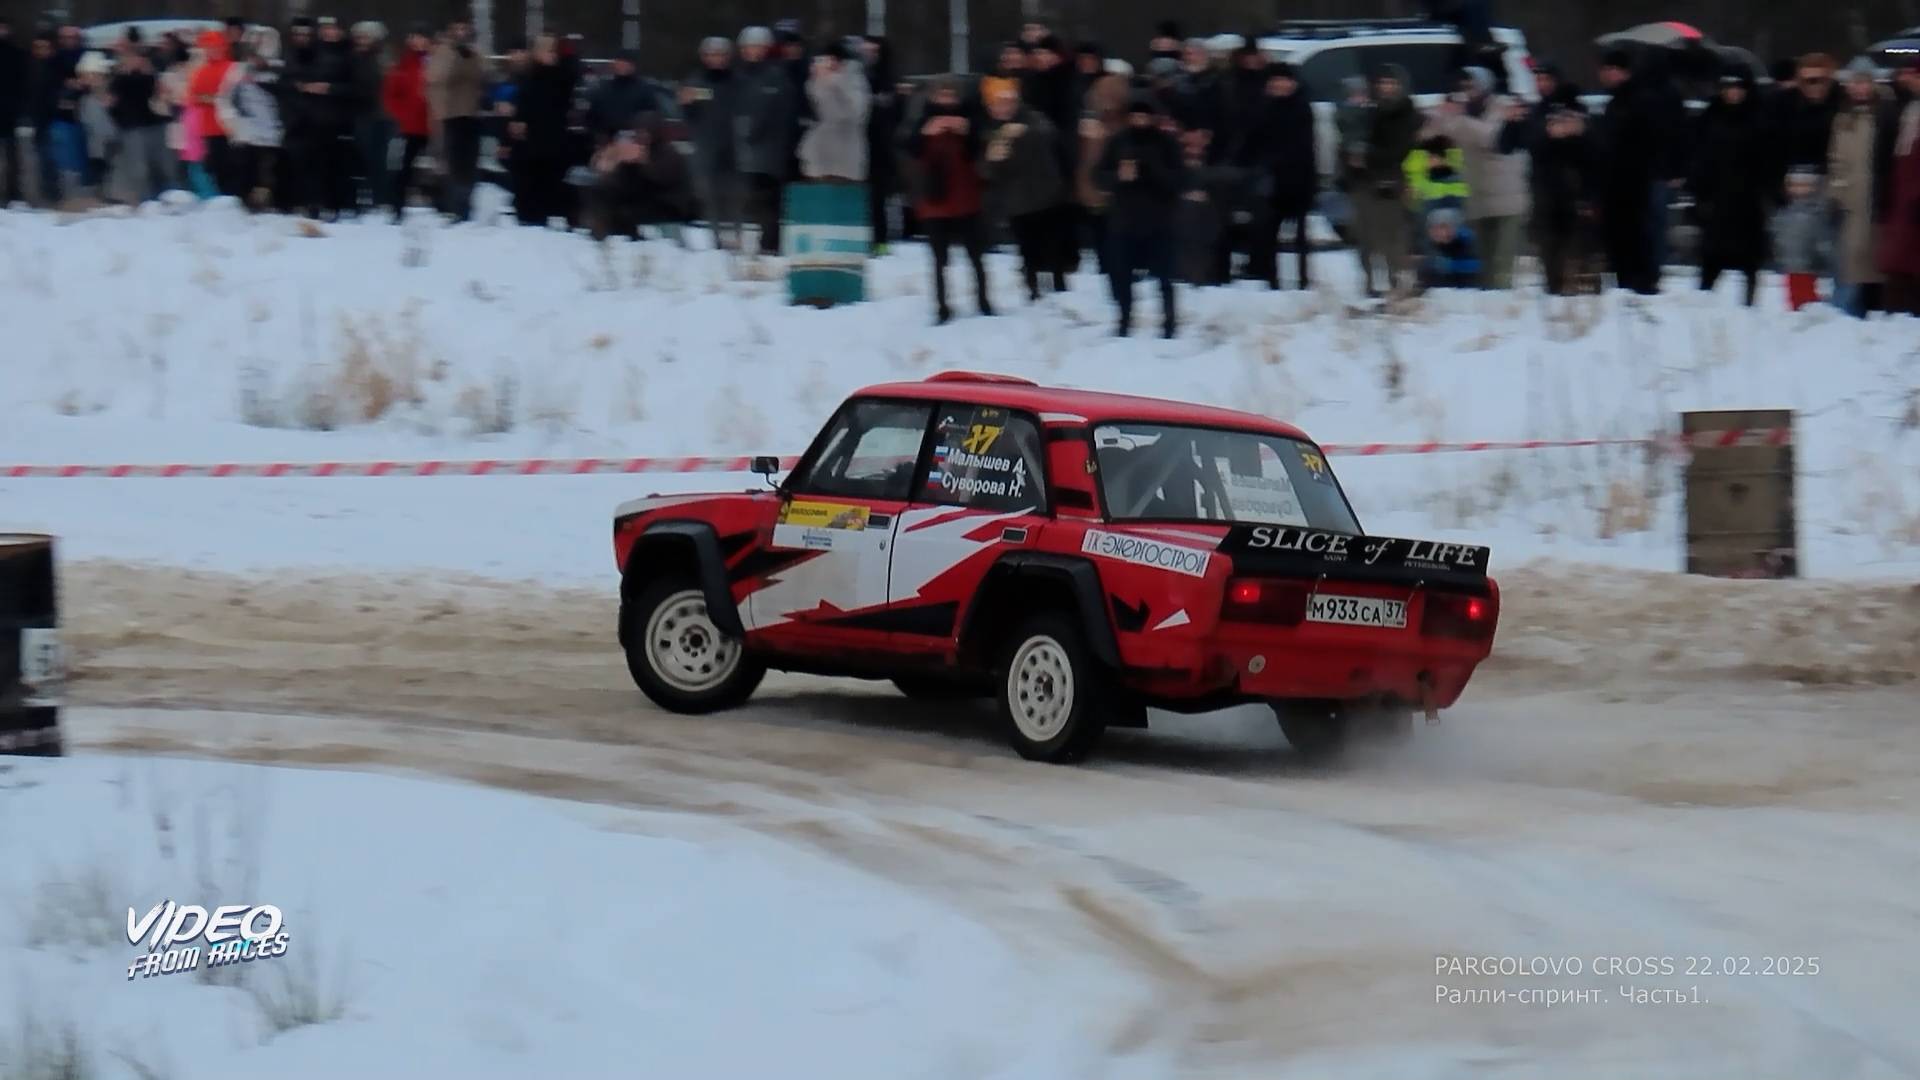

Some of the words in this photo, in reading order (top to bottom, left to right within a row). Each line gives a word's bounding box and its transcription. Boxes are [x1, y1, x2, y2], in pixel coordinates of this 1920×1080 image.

[948, 447, 1010, 472] Малышев
[942, 471, 1006, 497] Суворова
[1248, 526, 1353, 555] SLICE
[1365, 539, 1395, 565] of
[1406, 541, 1480, 566] LIFE
